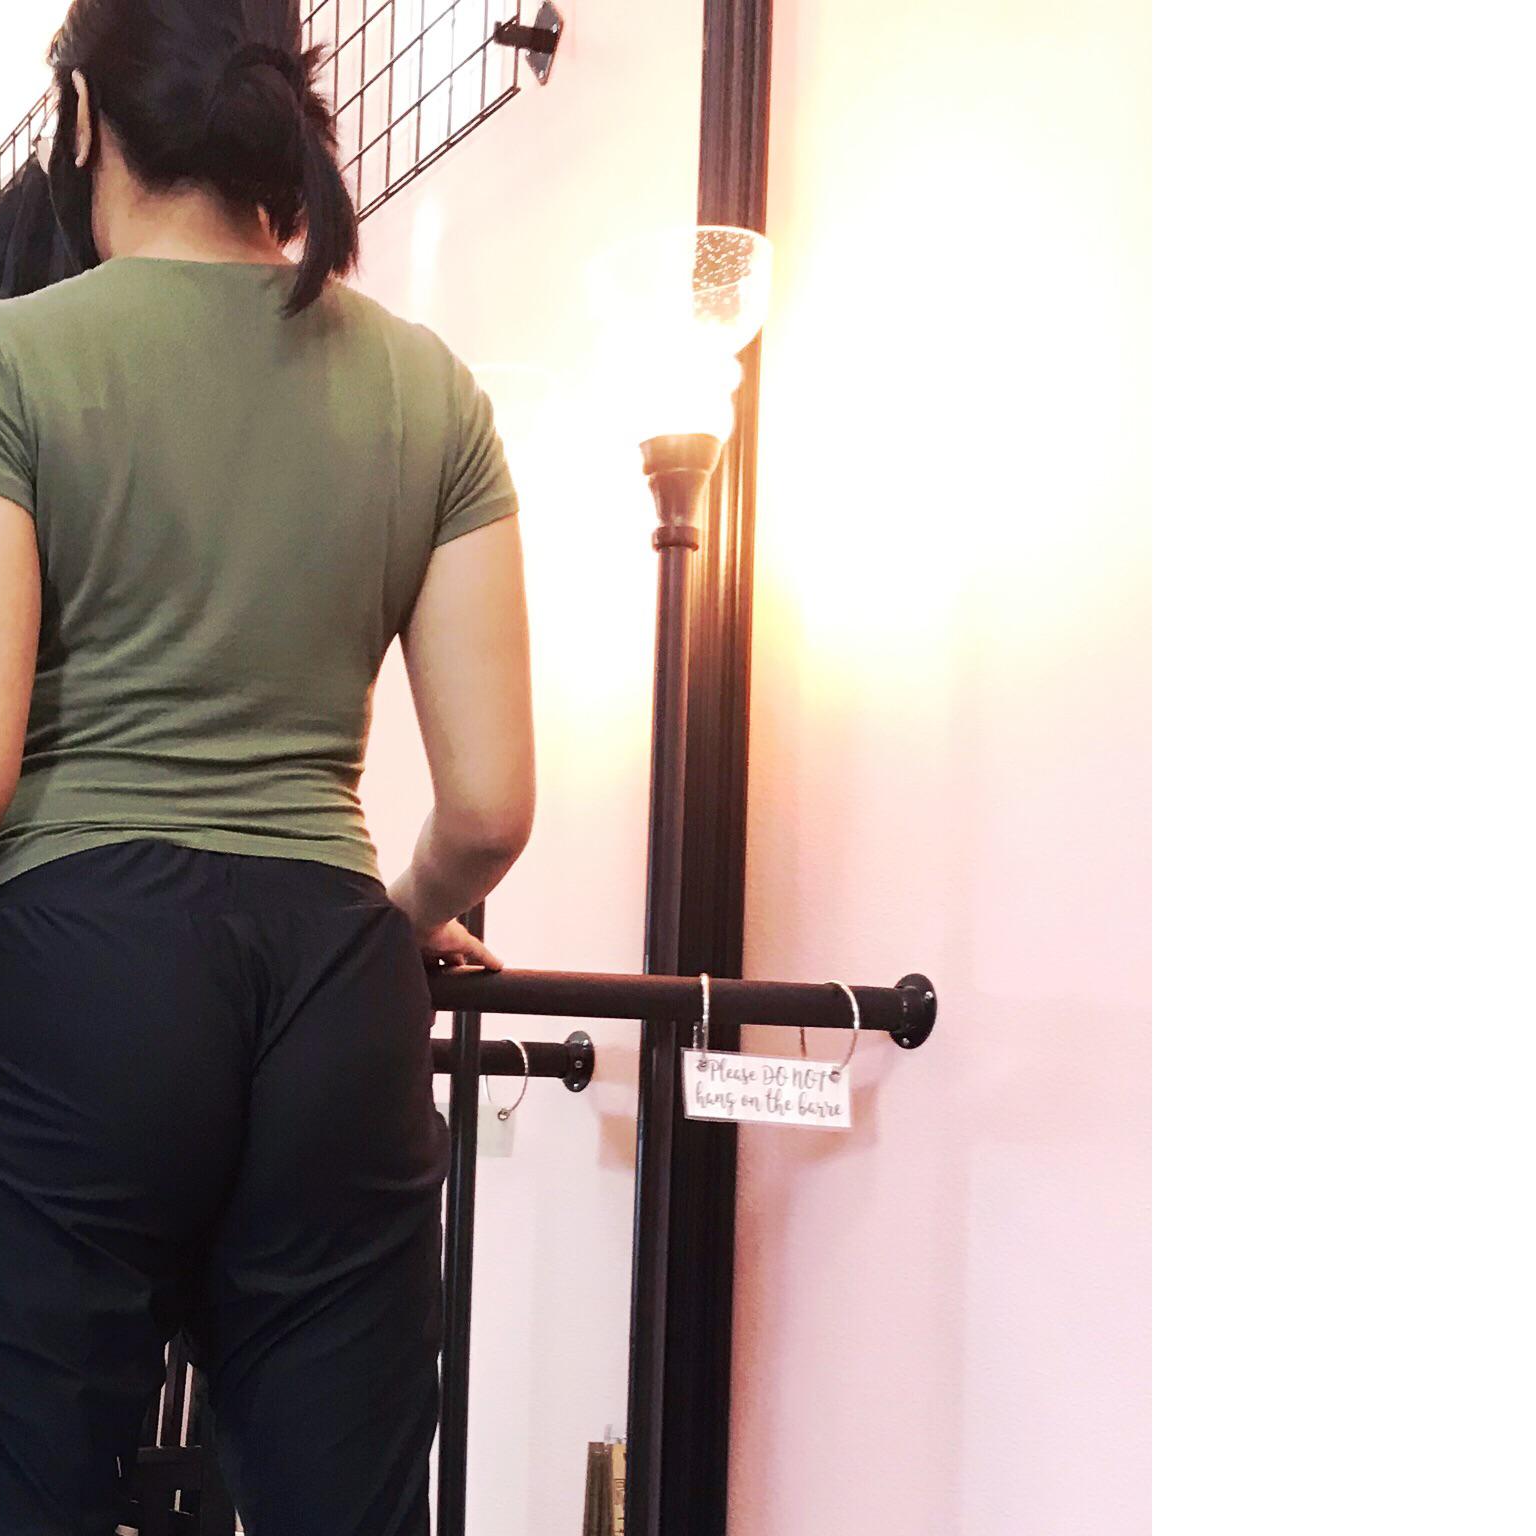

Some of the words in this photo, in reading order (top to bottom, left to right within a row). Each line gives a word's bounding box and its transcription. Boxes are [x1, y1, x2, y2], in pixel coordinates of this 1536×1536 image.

[707, 1058, 757, 1085] Please
[762, 1064, 789, 1086] DO
[792, 1068, 830, 1092] NOT
[696, 1081, 736, 1115] hang
[741, 1094, 761, 1112] on
[766, 1088, 793, 1116] the
[798, 1091, 843, 1119] barre
